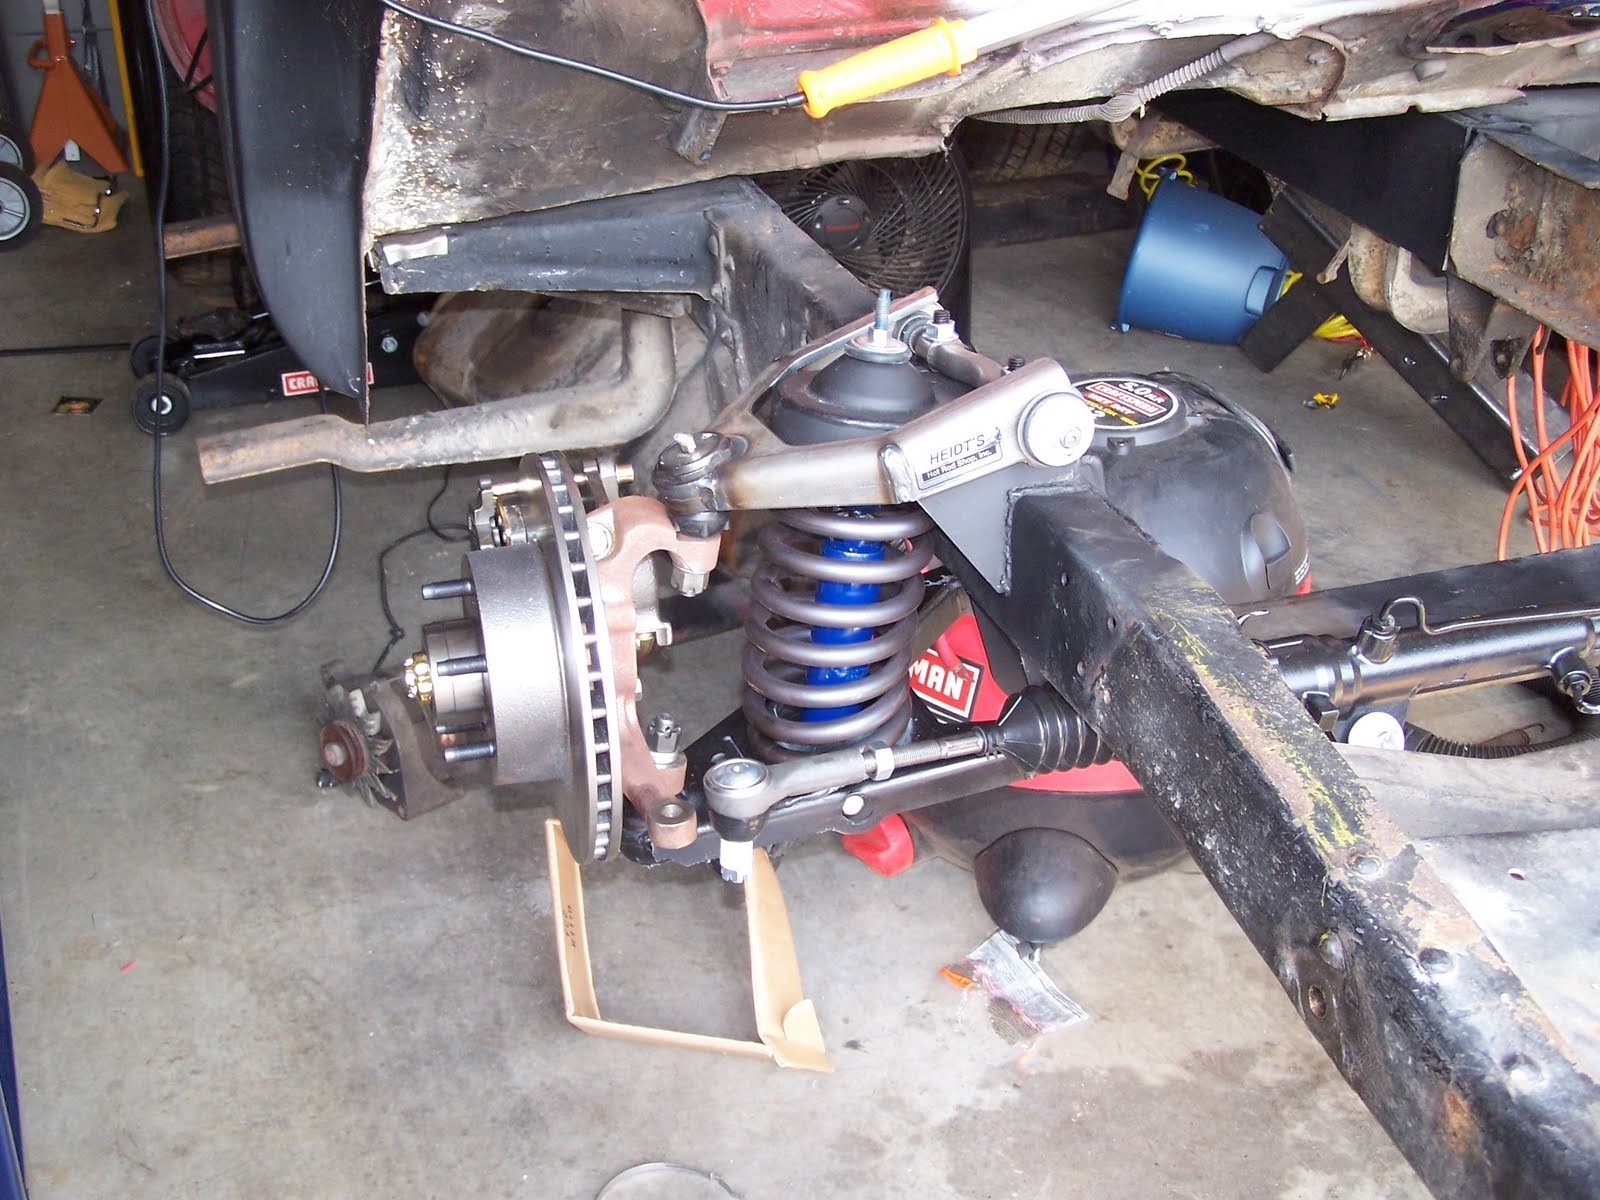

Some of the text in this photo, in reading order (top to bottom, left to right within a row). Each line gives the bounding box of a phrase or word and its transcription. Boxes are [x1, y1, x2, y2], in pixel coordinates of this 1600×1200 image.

[288, 376, 319, 391] CRA
[930, 434, 985, 465] HEIDT'S
[927, 467, 941, 479] Hot
[941, 461, 957, 474] Rod
[909, 658, 964, 701] MAN
